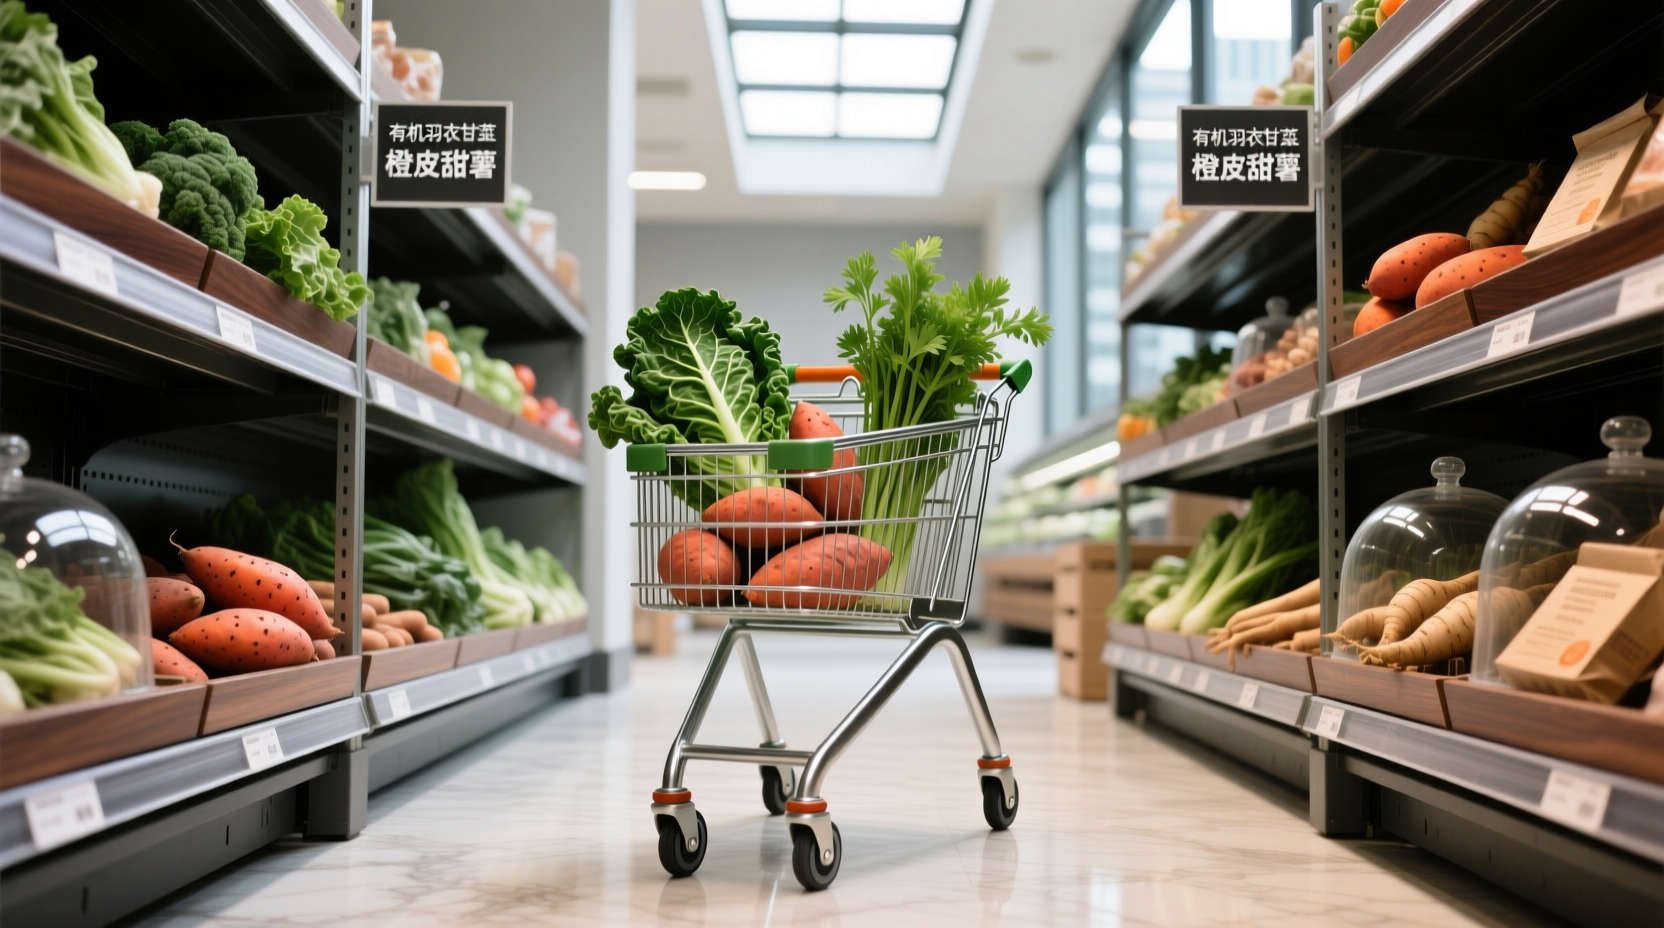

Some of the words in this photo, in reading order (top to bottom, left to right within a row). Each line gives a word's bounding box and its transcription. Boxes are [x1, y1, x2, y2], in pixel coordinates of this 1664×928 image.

[384, 148, 497, 180] 橙皮甜薯
[1191, 151, 1301, 182] 橙皮甜薯
